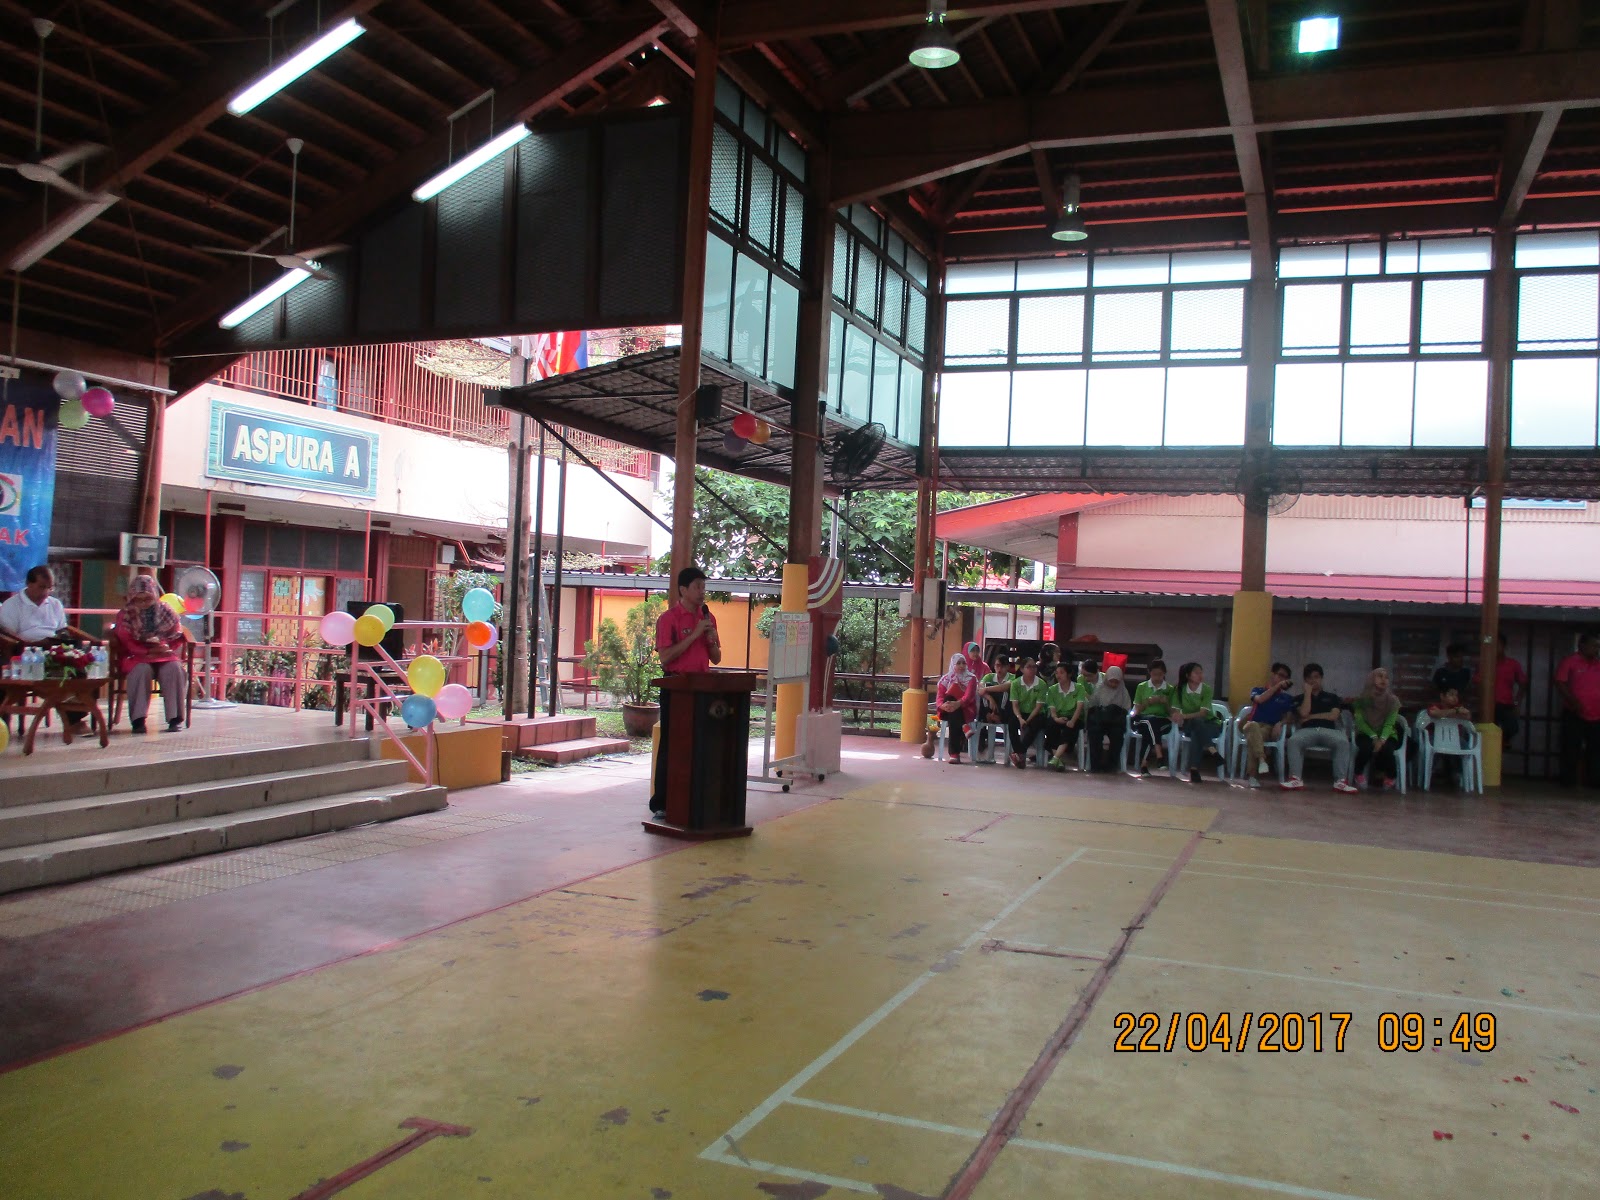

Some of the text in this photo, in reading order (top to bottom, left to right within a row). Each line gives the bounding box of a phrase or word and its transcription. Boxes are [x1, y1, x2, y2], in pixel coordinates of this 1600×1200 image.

[0, 404, 45, 449] AN
[232, 424, 361, 480] ASPURA A
